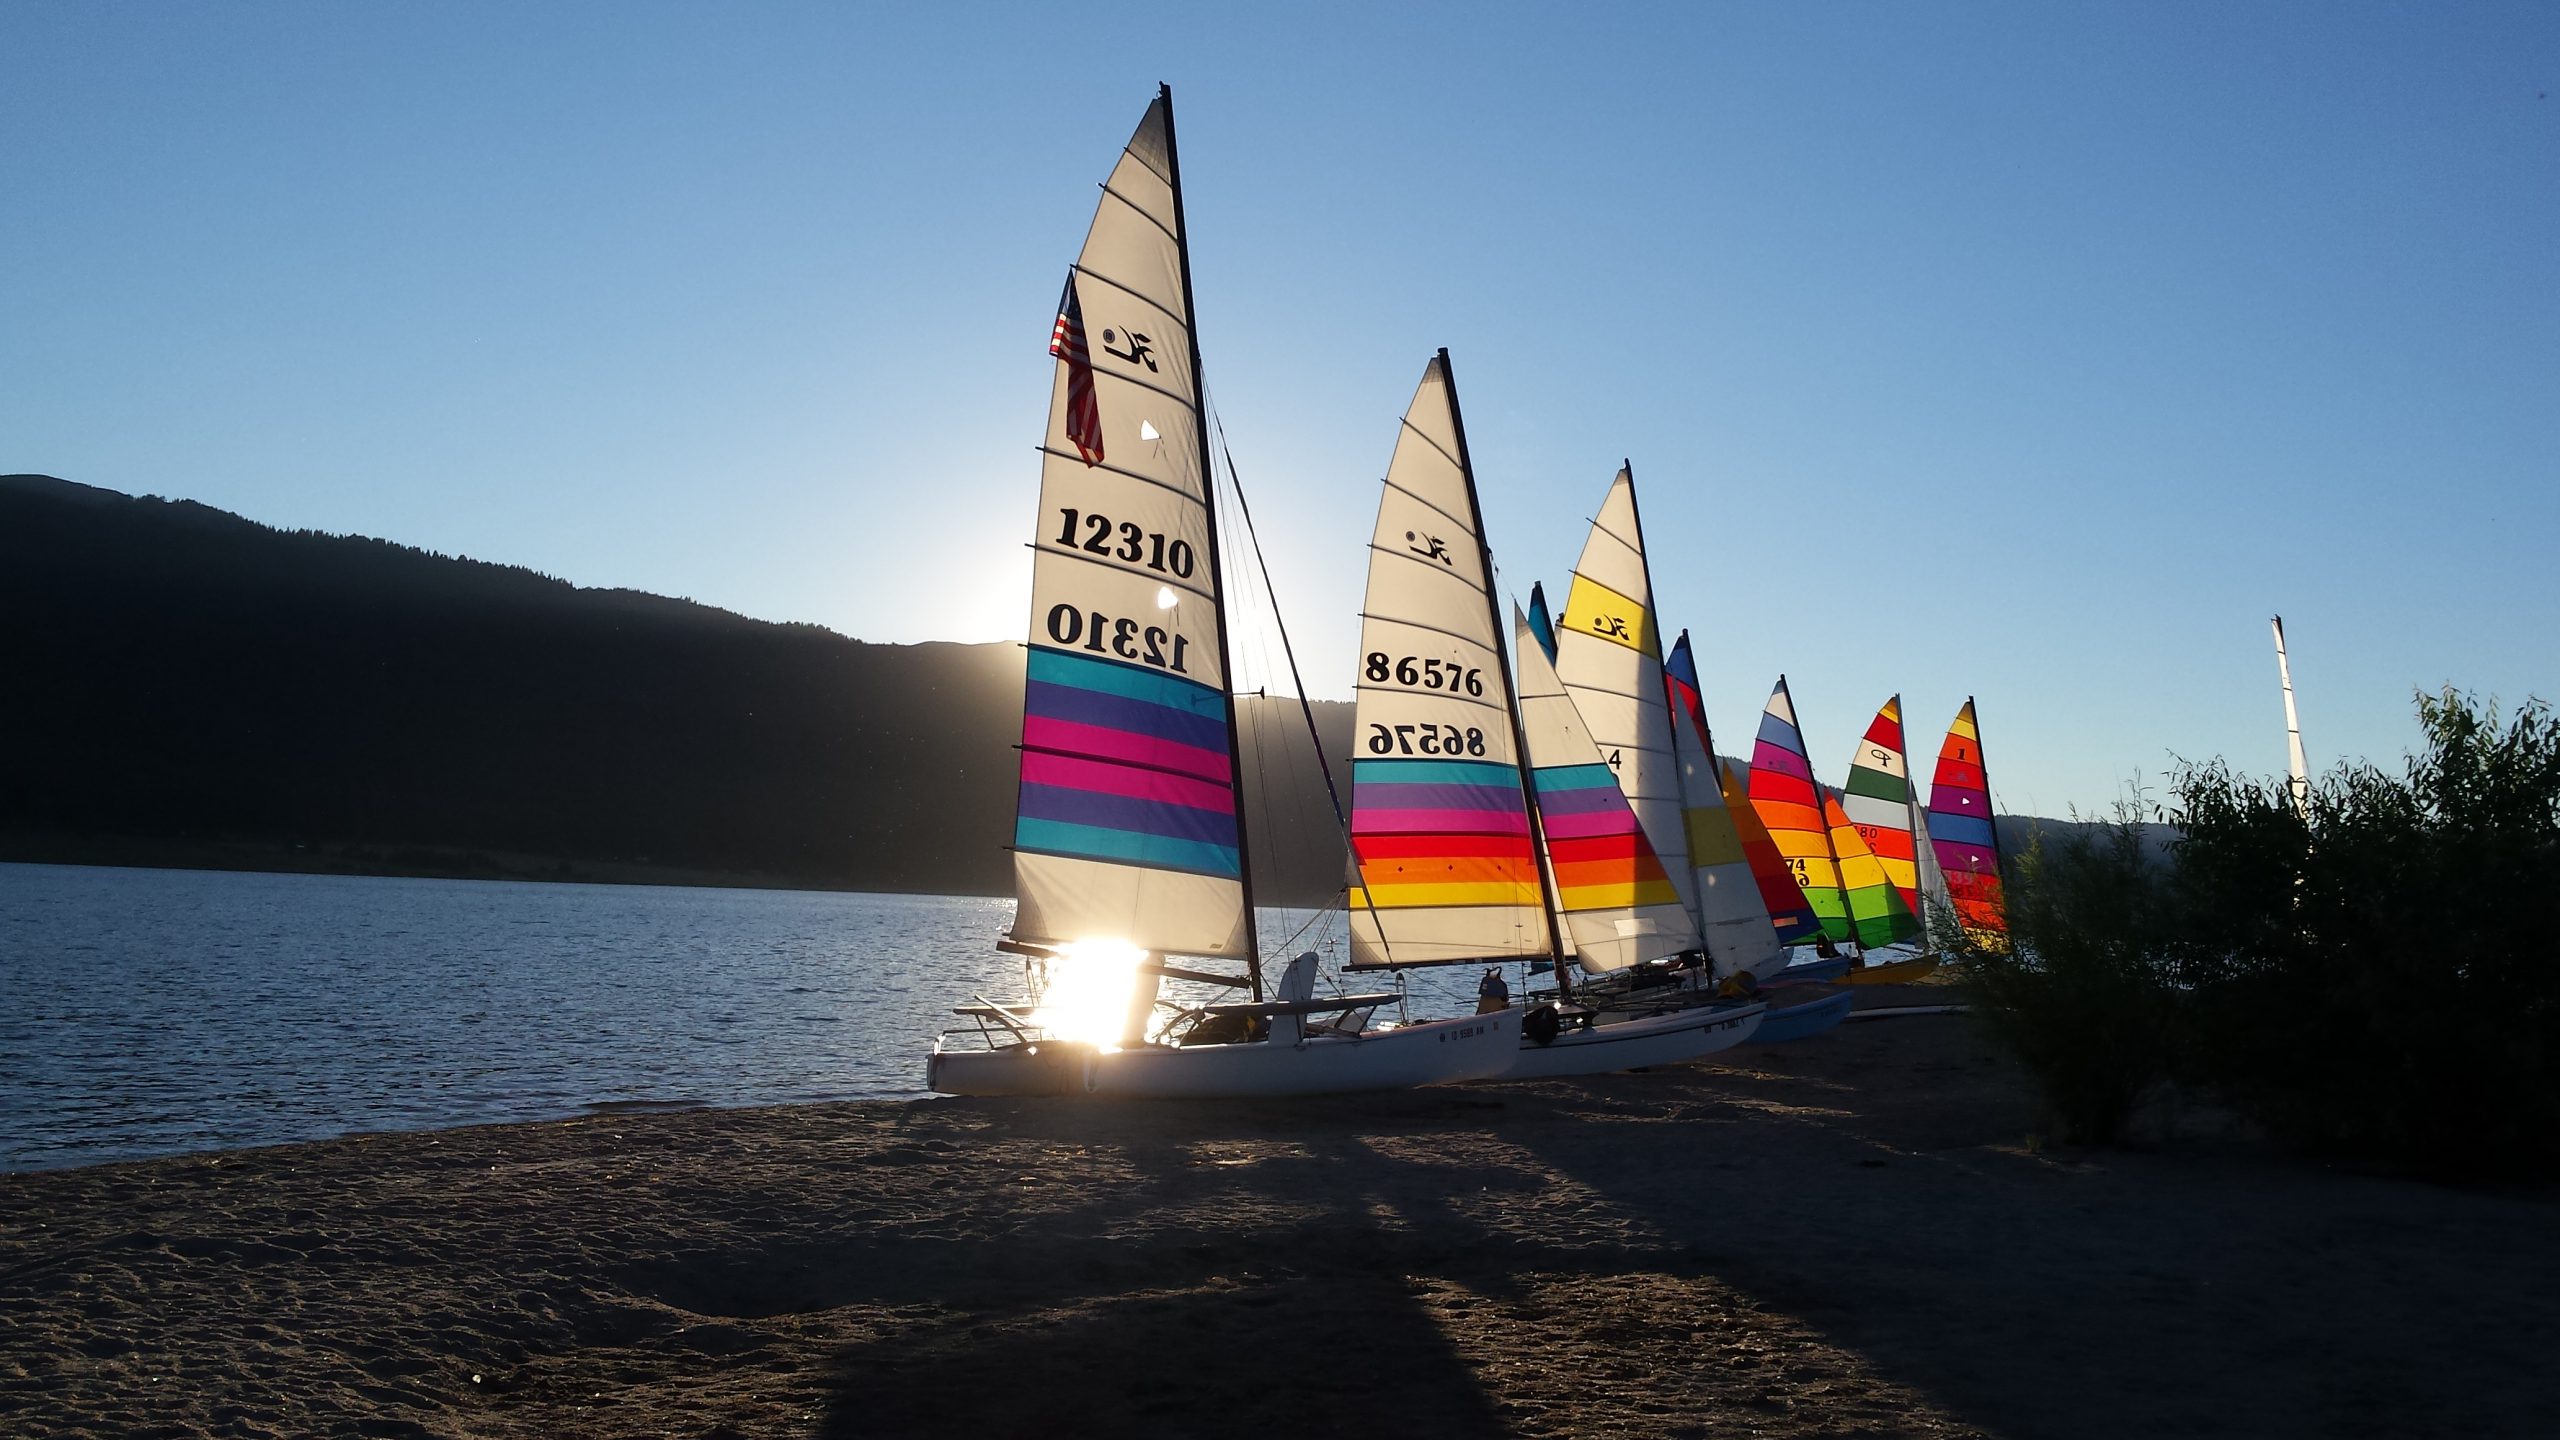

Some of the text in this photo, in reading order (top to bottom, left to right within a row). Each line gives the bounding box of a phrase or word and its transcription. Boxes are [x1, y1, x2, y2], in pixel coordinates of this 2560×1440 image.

[1055, 508, 1194, 579] 12310
[1365, 652, 1483, 697] 86576
[1608, 749, 1622, 770] 4
[1856, 826, 1878, 839] 80
